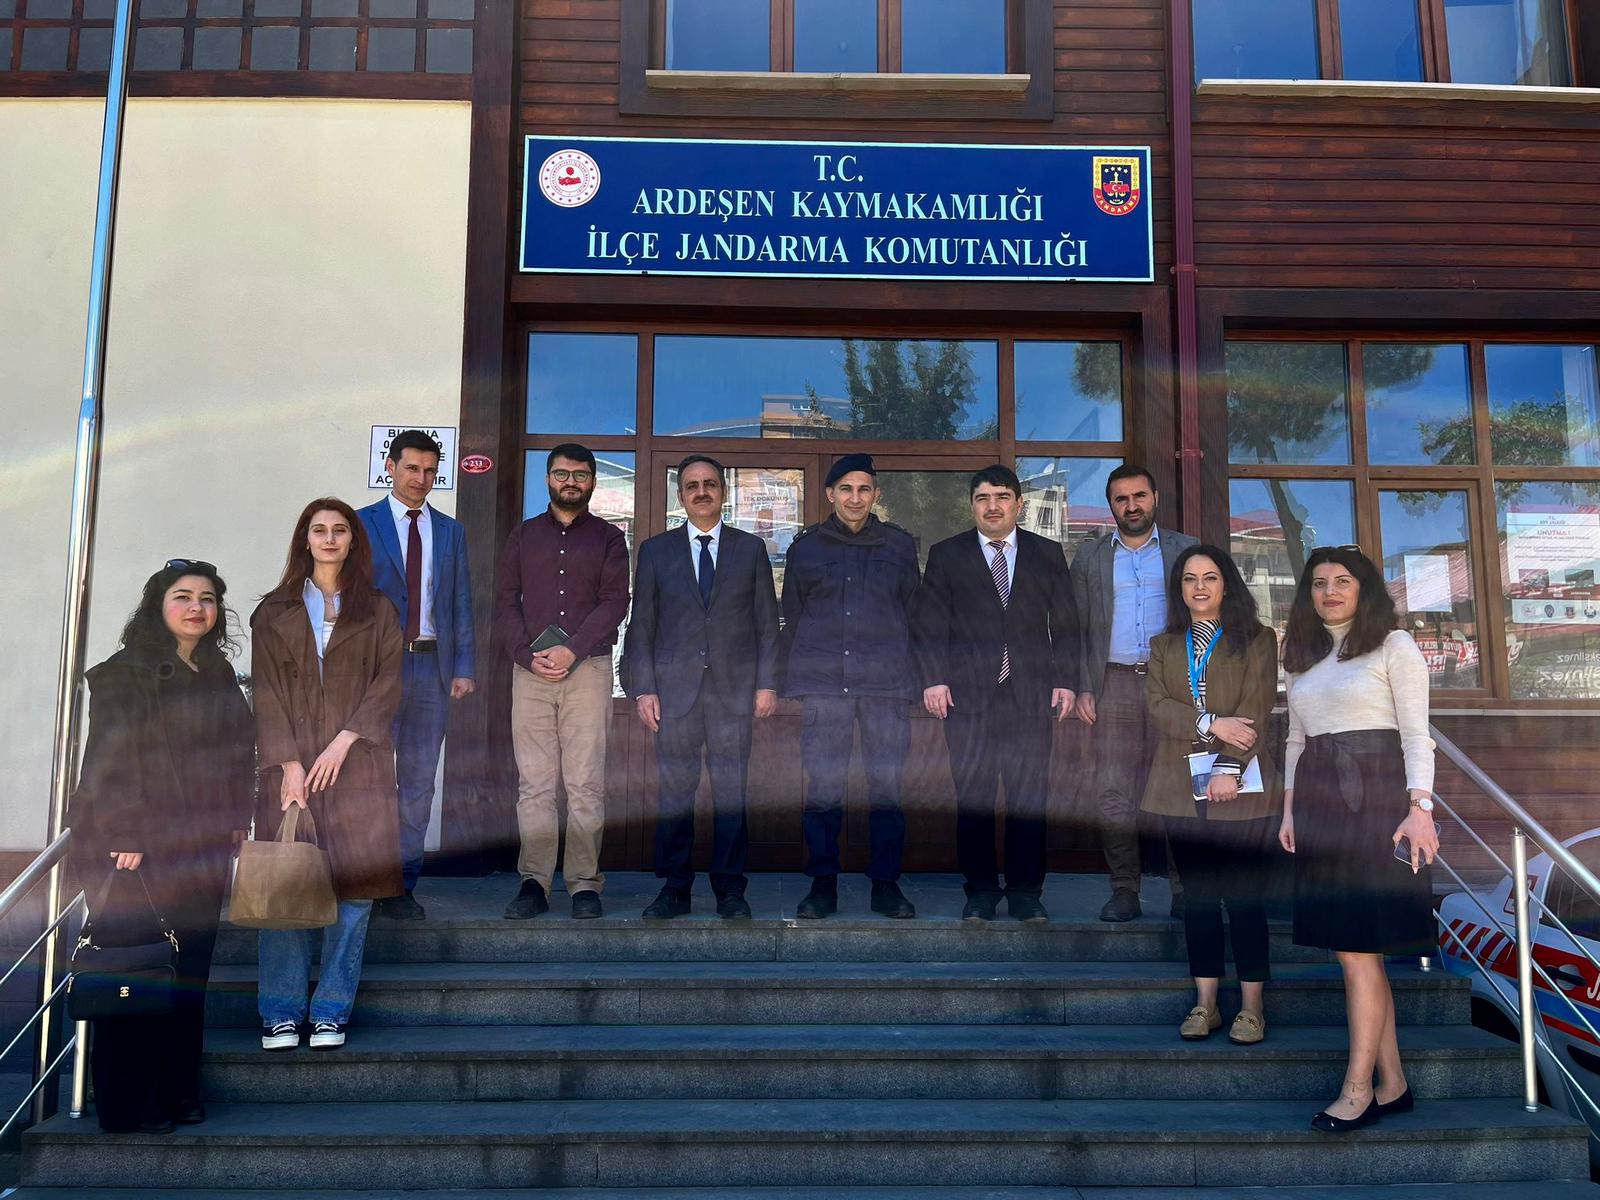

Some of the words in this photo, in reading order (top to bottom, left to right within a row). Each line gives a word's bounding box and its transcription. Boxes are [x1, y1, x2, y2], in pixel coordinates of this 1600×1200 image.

[813, 155, 864, 182] T.C.
[631, 188, 776, 223] ARDEŞEN
[791, 186, 1044, 222] KAYMAKAMLIĞI
[586, 224, 660, 266] İLÇE
[675, 233, 851, 264] JANDARMA
[864, 231, 1089, 267] KOMUTANLIĞI
